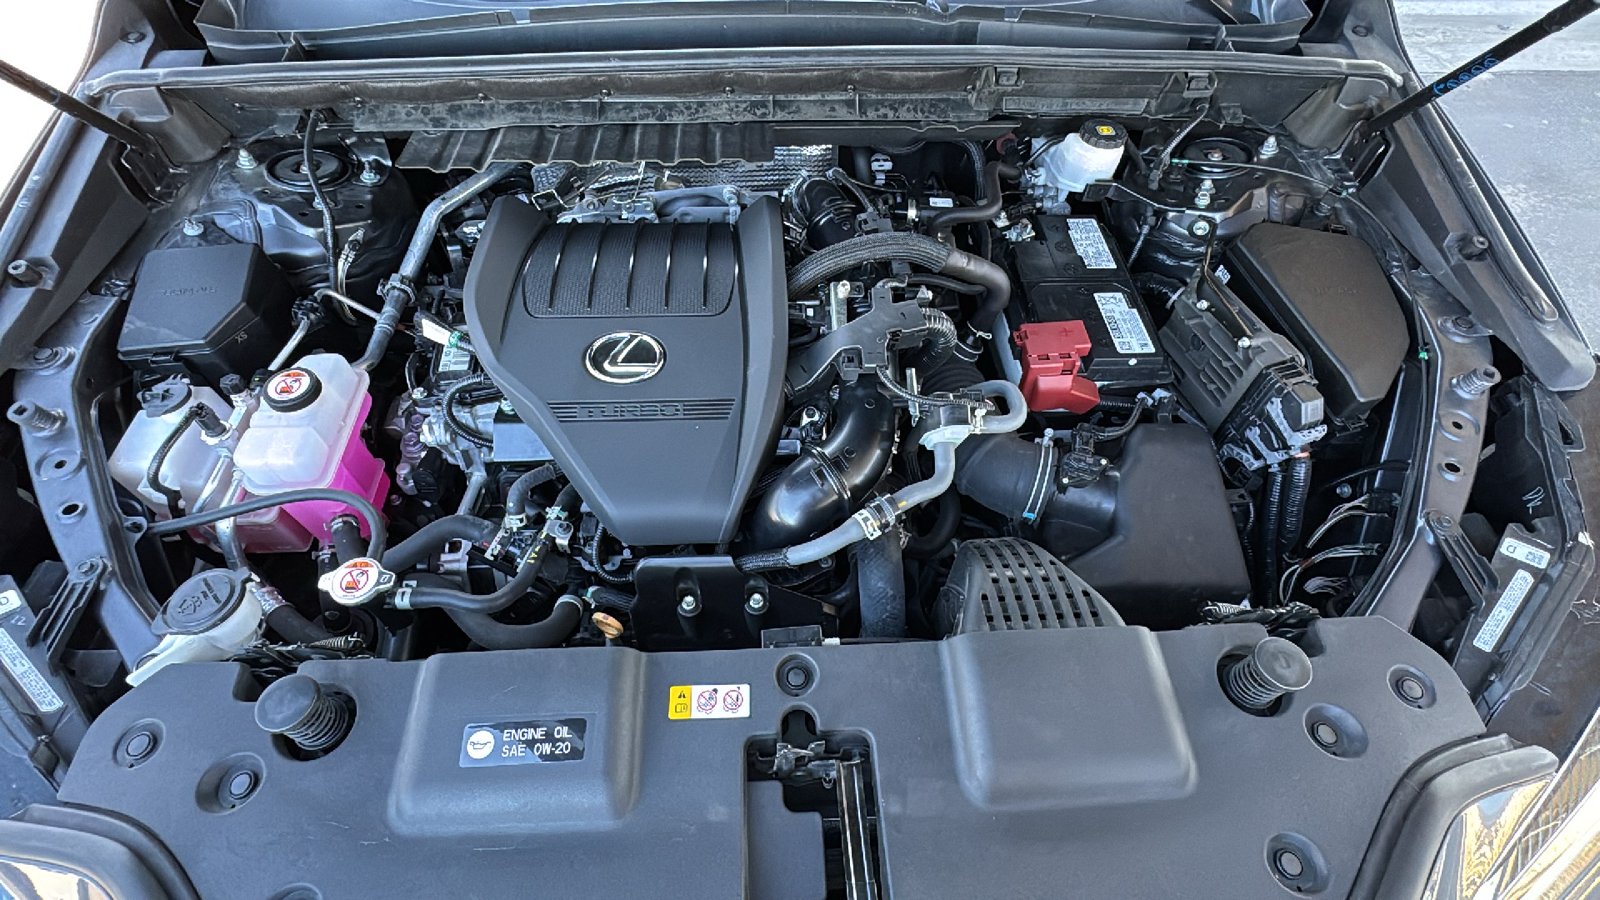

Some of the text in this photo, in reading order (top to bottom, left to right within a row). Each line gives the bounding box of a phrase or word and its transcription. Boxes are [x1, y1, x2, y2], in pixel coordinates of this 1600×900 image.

[579, 403, 681, 418] TURBO
[503, 726, 572, 741] ENGINE OIL
[501, 741, 571, 757] SAE 0W-20
